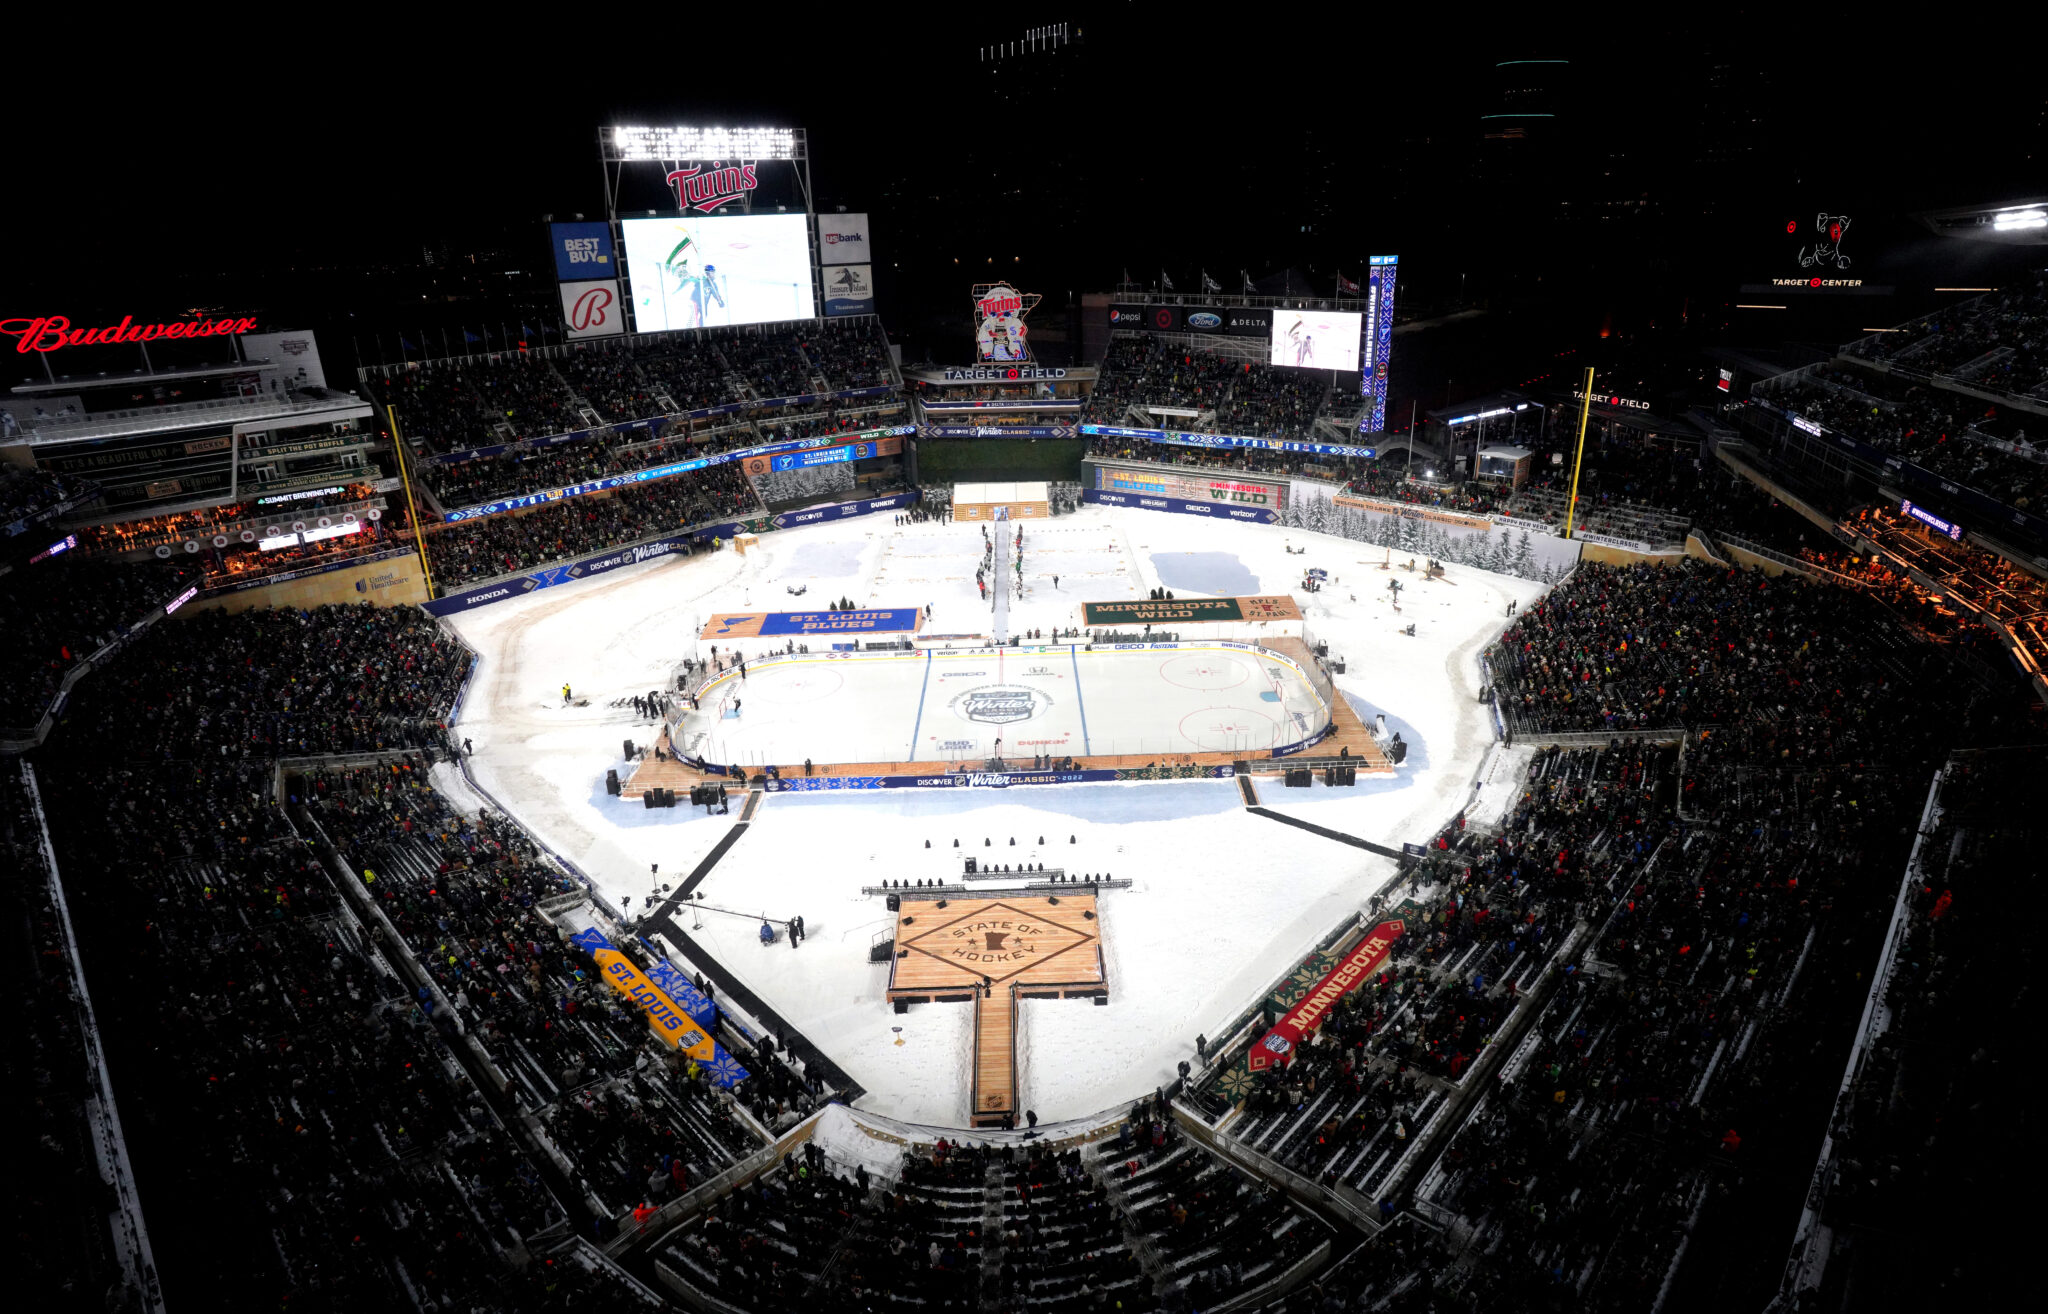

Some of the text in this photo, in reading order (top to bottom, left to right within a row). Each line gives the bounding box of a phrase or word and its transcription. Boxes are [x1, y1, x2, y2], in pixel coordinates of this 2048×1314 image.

[666, 161, 758, 211] Twins
[564, 238, 600, 252] BEST
[569, 250, 598, 263] BUY
[1772, 278, 1862, 287] TARGET CENTER
[572, 288, 612, 330] B
[978, 295, 1022, 318] Twins
[1120, 313, 1141, 323] pepsi
[1195, 314, 1215, 326] Ford
[1239, 319, 1267, 327] DELTA
[1365, 285, 1377, 368] #WINTERCLASSIC
[0, 315, 256, 353] Budweiser
[945, 368, 1066, 380] TARGET FIELD
[1620, 399, 1650, 409] FIELD
[976, 427, 1003, 438] Winter
[267, 439, 345, 455] SPLIT THE POT RAFFLE
[96, 450, 149, 467] BEAUTIFUL
[151, 447, 169, 458] DAY
[834, 454, 847, 462] WILD
[1120, 473, 1159, 484] ST. LOUIS
[1113, 480, 1166, 493] BLUES
[1215, 482, 1262, 494] MINNESOTA
[264, 487, 338, 505] SUMMIT BREWING PUB
[1100, 494, 1126, 503] DISCOVER
[1210, 488, 1268, 504] WILD
[841, 505, 858, 513] TRULY
[871, 498, 896, 508] DUNKIN'
[1185, 504, 1211, 513] GEICO
[796, 512, 823, 522] DISCOVER
[1230, 509, 1255, 518] verizon
[1335, 500, 1364, 509] WELCOME
[1400, 507, 1425, 519] Winter
[1425, 515, 1451, 523] CLASSIC
[1499, 517, 1517, 526] HAPPY
[1532, 523, 1548, 531] YEAR
[1583, 533, 1639, 549] #WINTERCLASSIC
[590, 542, 670, 571] DISCOVER Winter
[369, 573, 393, 583] United
[372, 577, 409, 590] Healthcare
[467, 588, 509, 604] HONDA
[1096, 602, 1230, 612] MINNESOTA
[789, 611, 893, 623] ST. LOUIS
[1134, 610, 1193, 619] WILD
[802, 620, 875, 630] BLUES
[711, 668, 732, 684] DISCOVER
[964, 699, 1037, 713] Winter
[917, 778, 952, 786] DISCOVER
[967, 773, 1011, 788] Winter
[1011, 776, 1056, 784] CLASSIC
[953, 922, 1042, 938] STATE OF
[952, 945, 1036, 963] HOCKEY
[1288, 936, 1389, 1031] MINNESOTA
[608, 961, 683, 1031] ST. LOUIS
